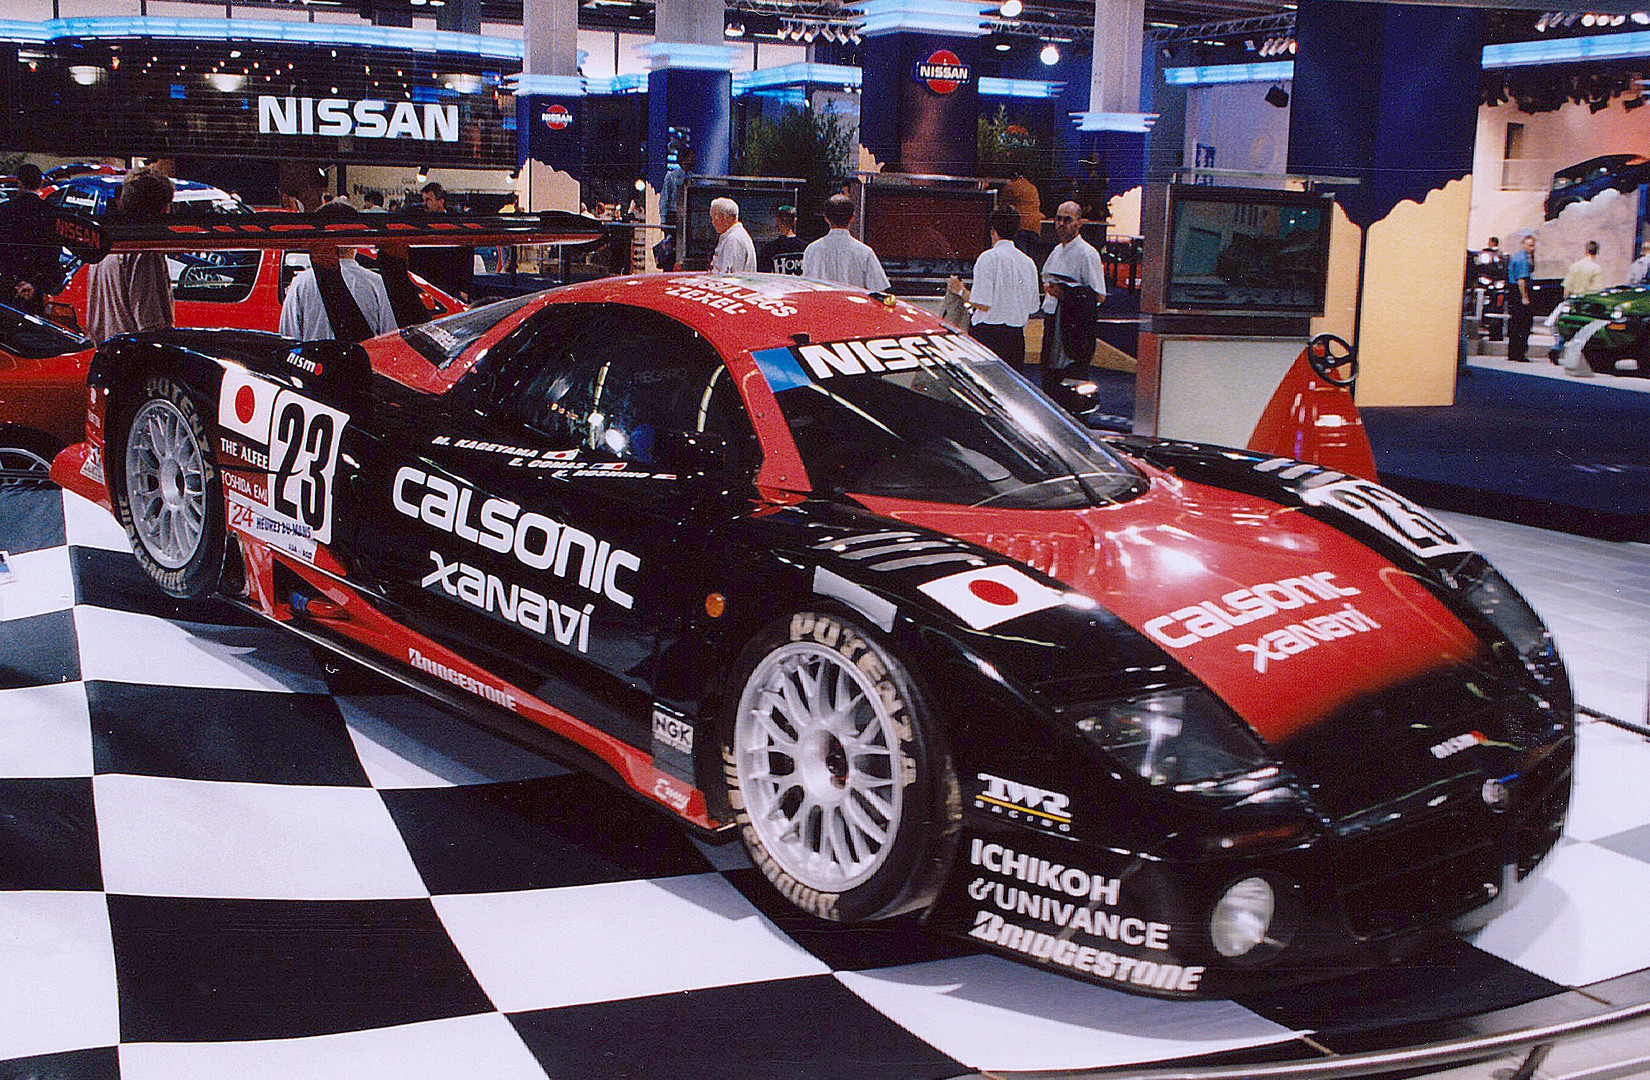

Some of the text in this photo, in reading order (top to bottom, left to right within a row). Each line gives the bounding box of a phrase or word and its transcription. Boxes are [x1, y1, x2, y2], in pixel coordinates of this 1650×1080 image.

[920, 65, 968, 79] NISSAN
[258, 95, 459, 142] NISSAN
[541, 112, 573, 122] NISSAN
[55, 217, 100, 248] NISSAN
[798, 333, 999, 380] NISSAN
[221, 437, 268, 470] THE ALFEE
[273, 402, 334, 531] 23
[432, 435, 539, 458] M. KAGEYAMA
[221, 469, 267, 503] TOSHIBA EMI
[232, 504, 253, 528] 24
[1331, 485, 1459, 550] 23
[408, 647, 518, 712] BRIDGESTONE
[656, 717, 691, 745] NGK
[970, 838, 1121, 906] ICHIKOH
[995, 882, 1172, 950] UNIVANCE
[968, 910, 1207, 991] BRIDGESTONE
